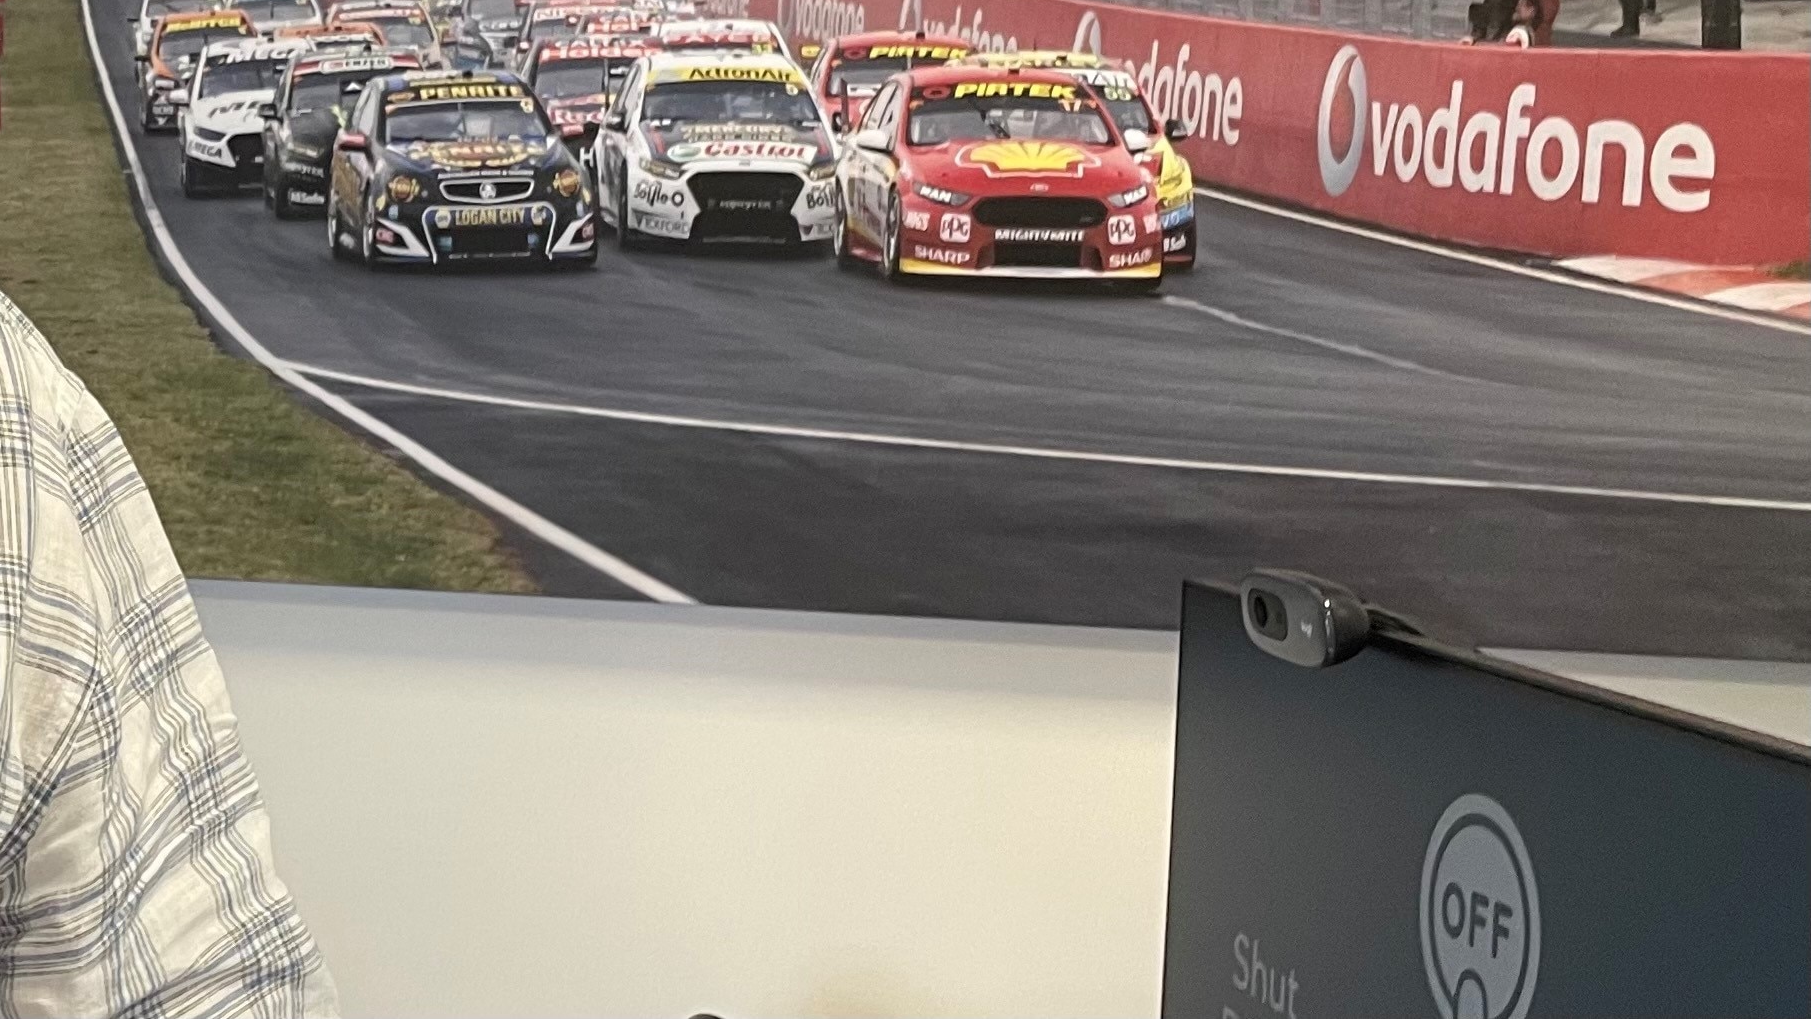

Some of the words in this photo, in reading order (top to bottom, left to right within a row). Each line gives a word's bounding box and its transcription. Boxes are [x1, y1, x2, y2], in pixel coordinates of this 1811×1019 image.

[689, 68, 791, 81] ActronAir
[419, 84, 524, 100] PENRITE
[954, 83, 1076, 99] PIRTEK
[1124, 39, 1243, 146] dafone
[704, 142, 805, 159] Castrol
[1371, 80, 1716, 213] vodafone
[455, 209, 496, 226] LOGAN
[499, 208, 526, 224] CITY
[914, 244, 971, 265] SHARP
[1441, 881, 1513, 959] OFF
[1232, 932, 1300, 1019] Shut
